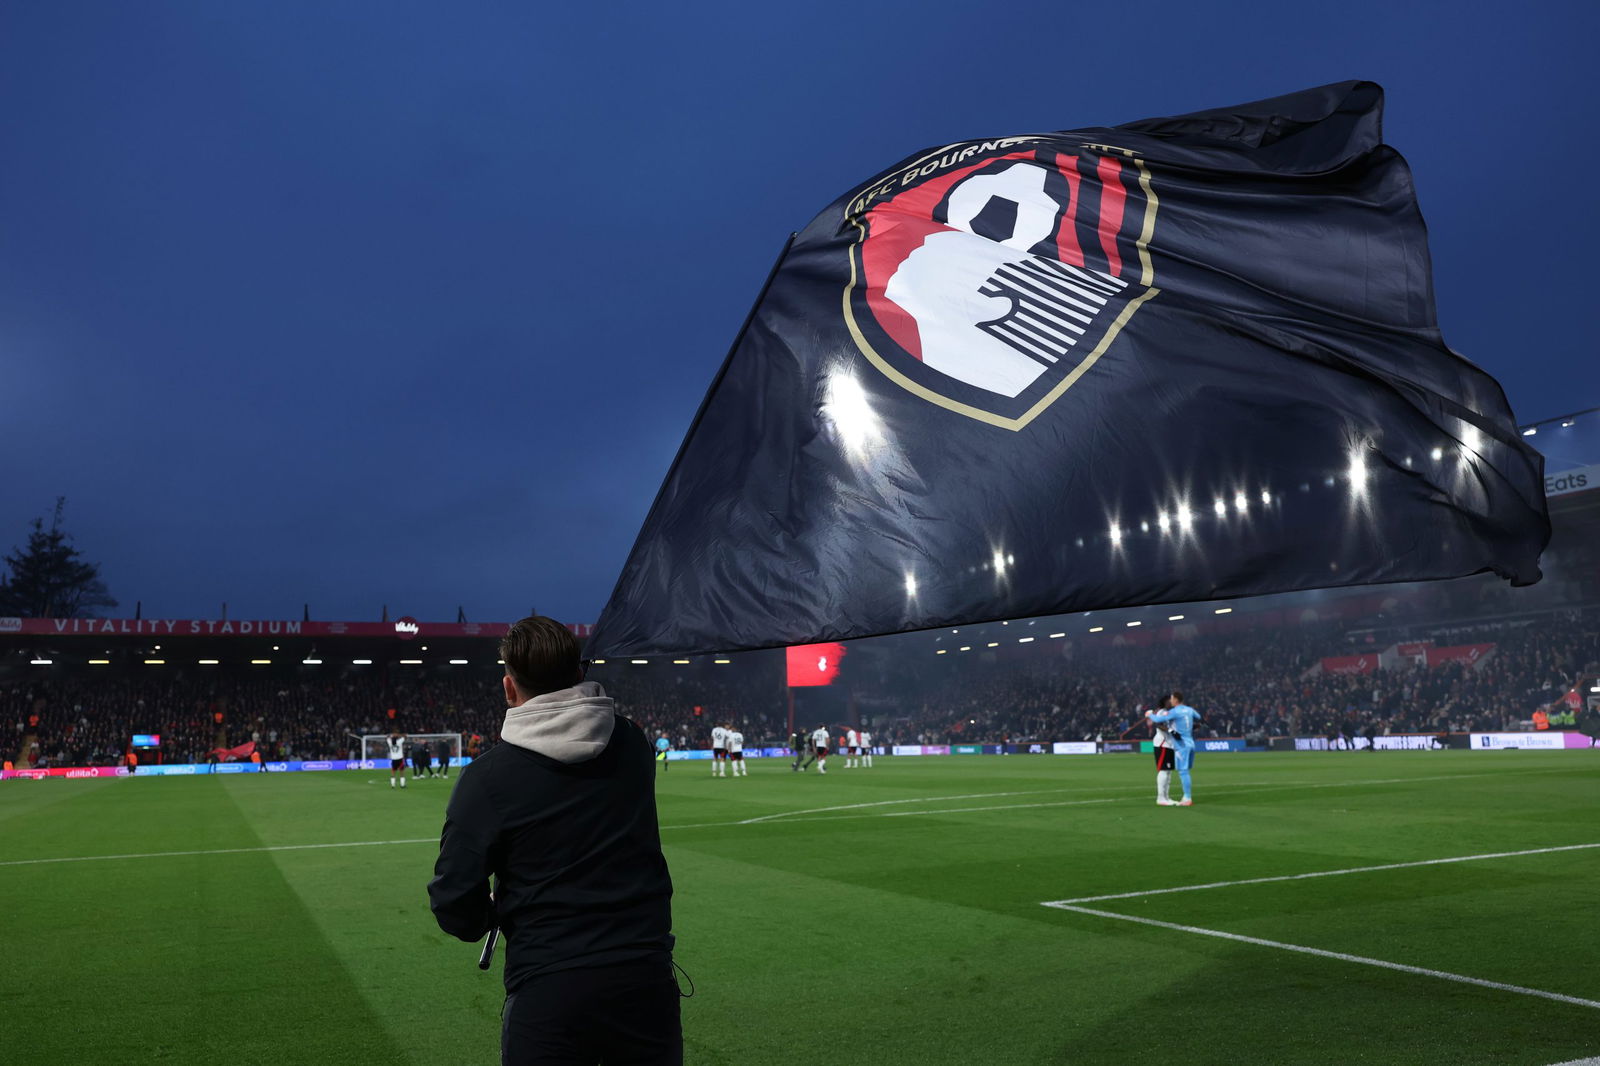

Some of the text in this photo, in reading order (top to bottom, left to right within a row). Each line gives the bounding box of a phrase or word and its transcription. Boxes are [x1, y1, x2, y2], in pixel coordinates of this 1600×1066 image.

[854, 178, 897, 214] AFC
[1545, 473, 1588, 493] Eats
[54, 619, 301, 634] VITALITY STADIUM
